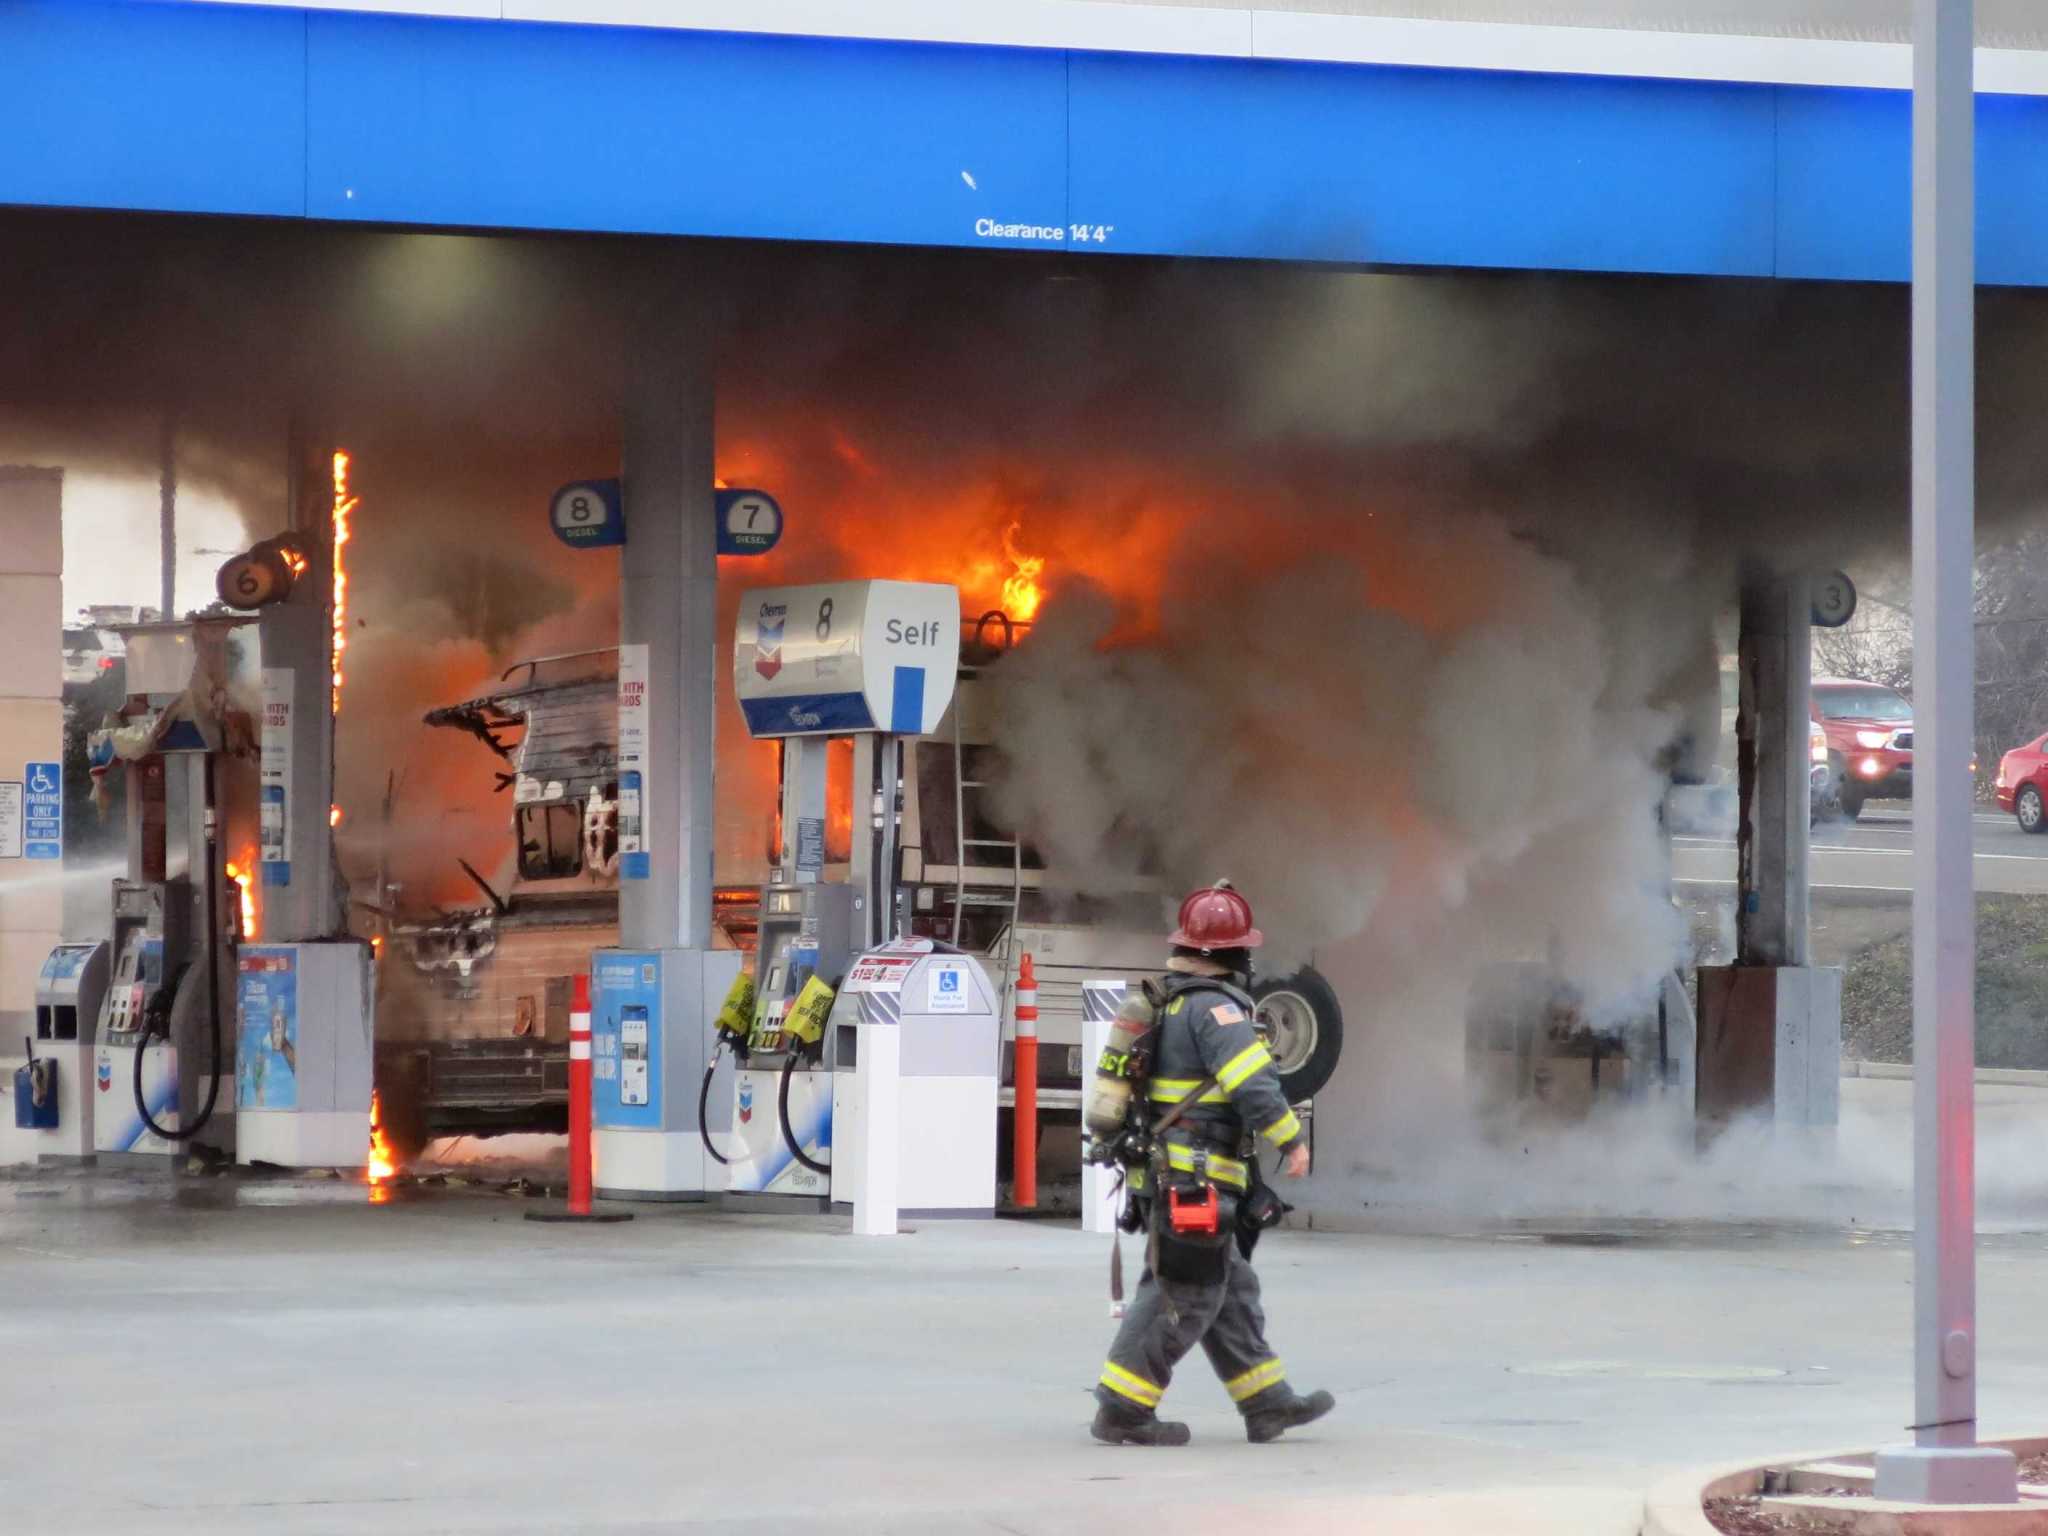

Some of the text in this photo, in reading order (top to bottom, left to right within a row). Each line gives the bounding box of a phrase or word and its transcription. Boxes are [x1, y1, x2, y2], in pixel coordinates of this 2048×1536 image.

[975, 218, 1064, 240] Clearance
[571, 496, 591, 521] 8
[742, 504, 760, 529] 7
[736, 534, 768, 545] DIESEL
[236, 567, 259, 596] 6
[1825, 585, 1842, 610] 3
[815, 597, 833, 644] 8
[886, 618, 940, 646] Self
[26, 792, 60, 805] PARKING
[32, 805, 53, 818] ONLY
